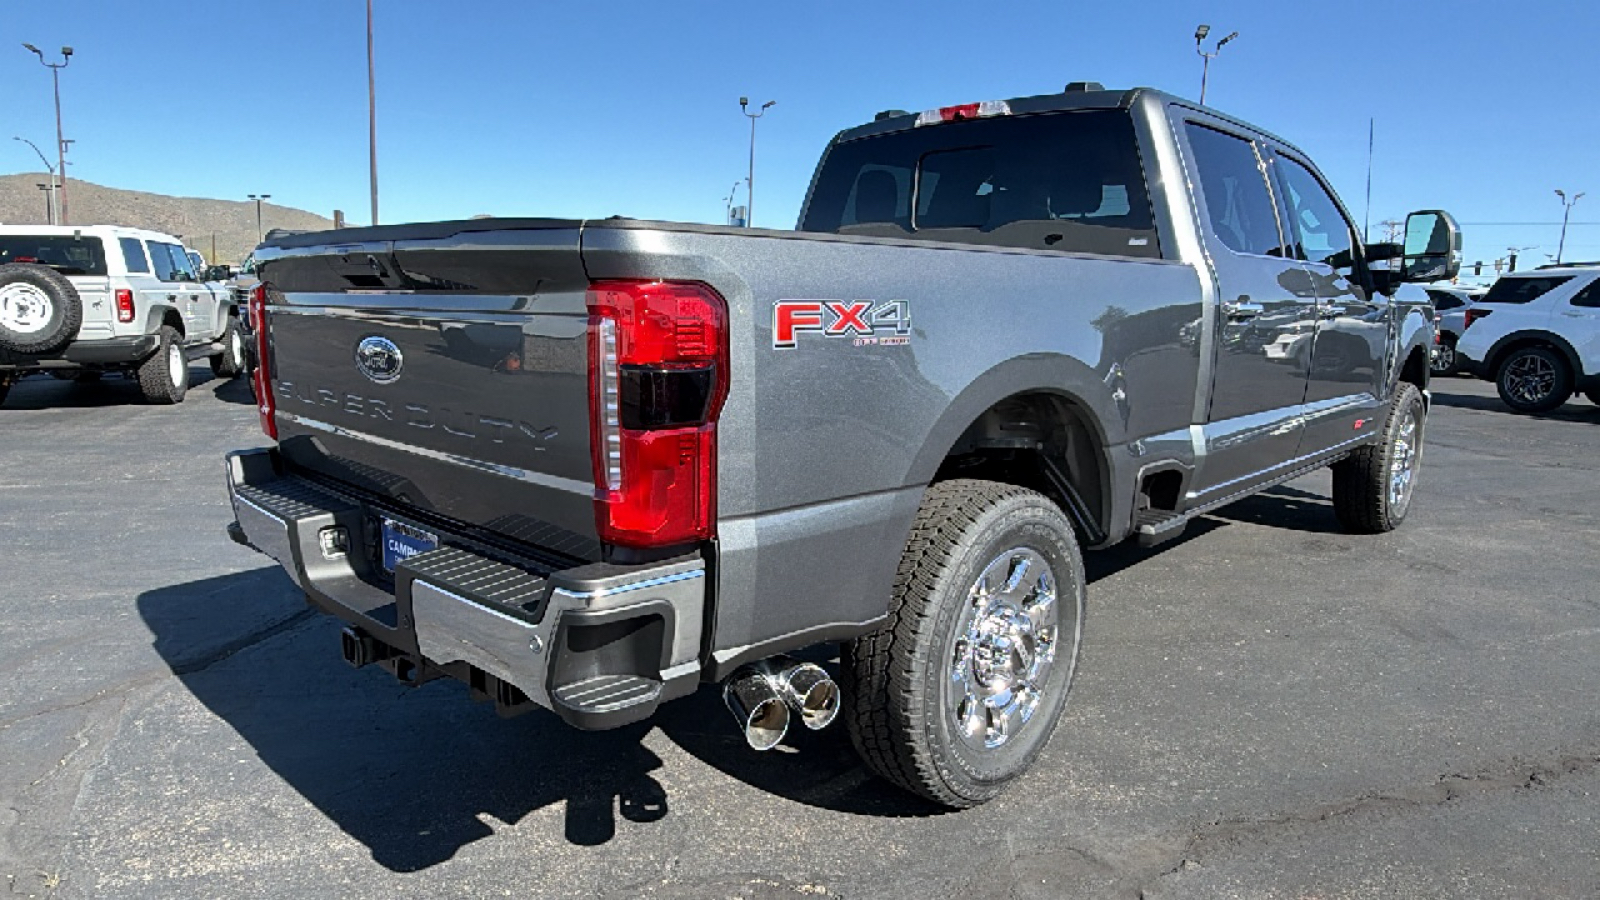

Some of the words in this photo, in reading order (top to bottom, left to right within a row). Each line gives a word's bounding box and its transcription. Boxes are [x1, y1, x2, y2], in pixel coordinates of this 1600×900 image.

[772, 298, 911, 350] FX4
[278, 379, 394, 421] SUPER
[405, 402, 559, 451] DUTY
